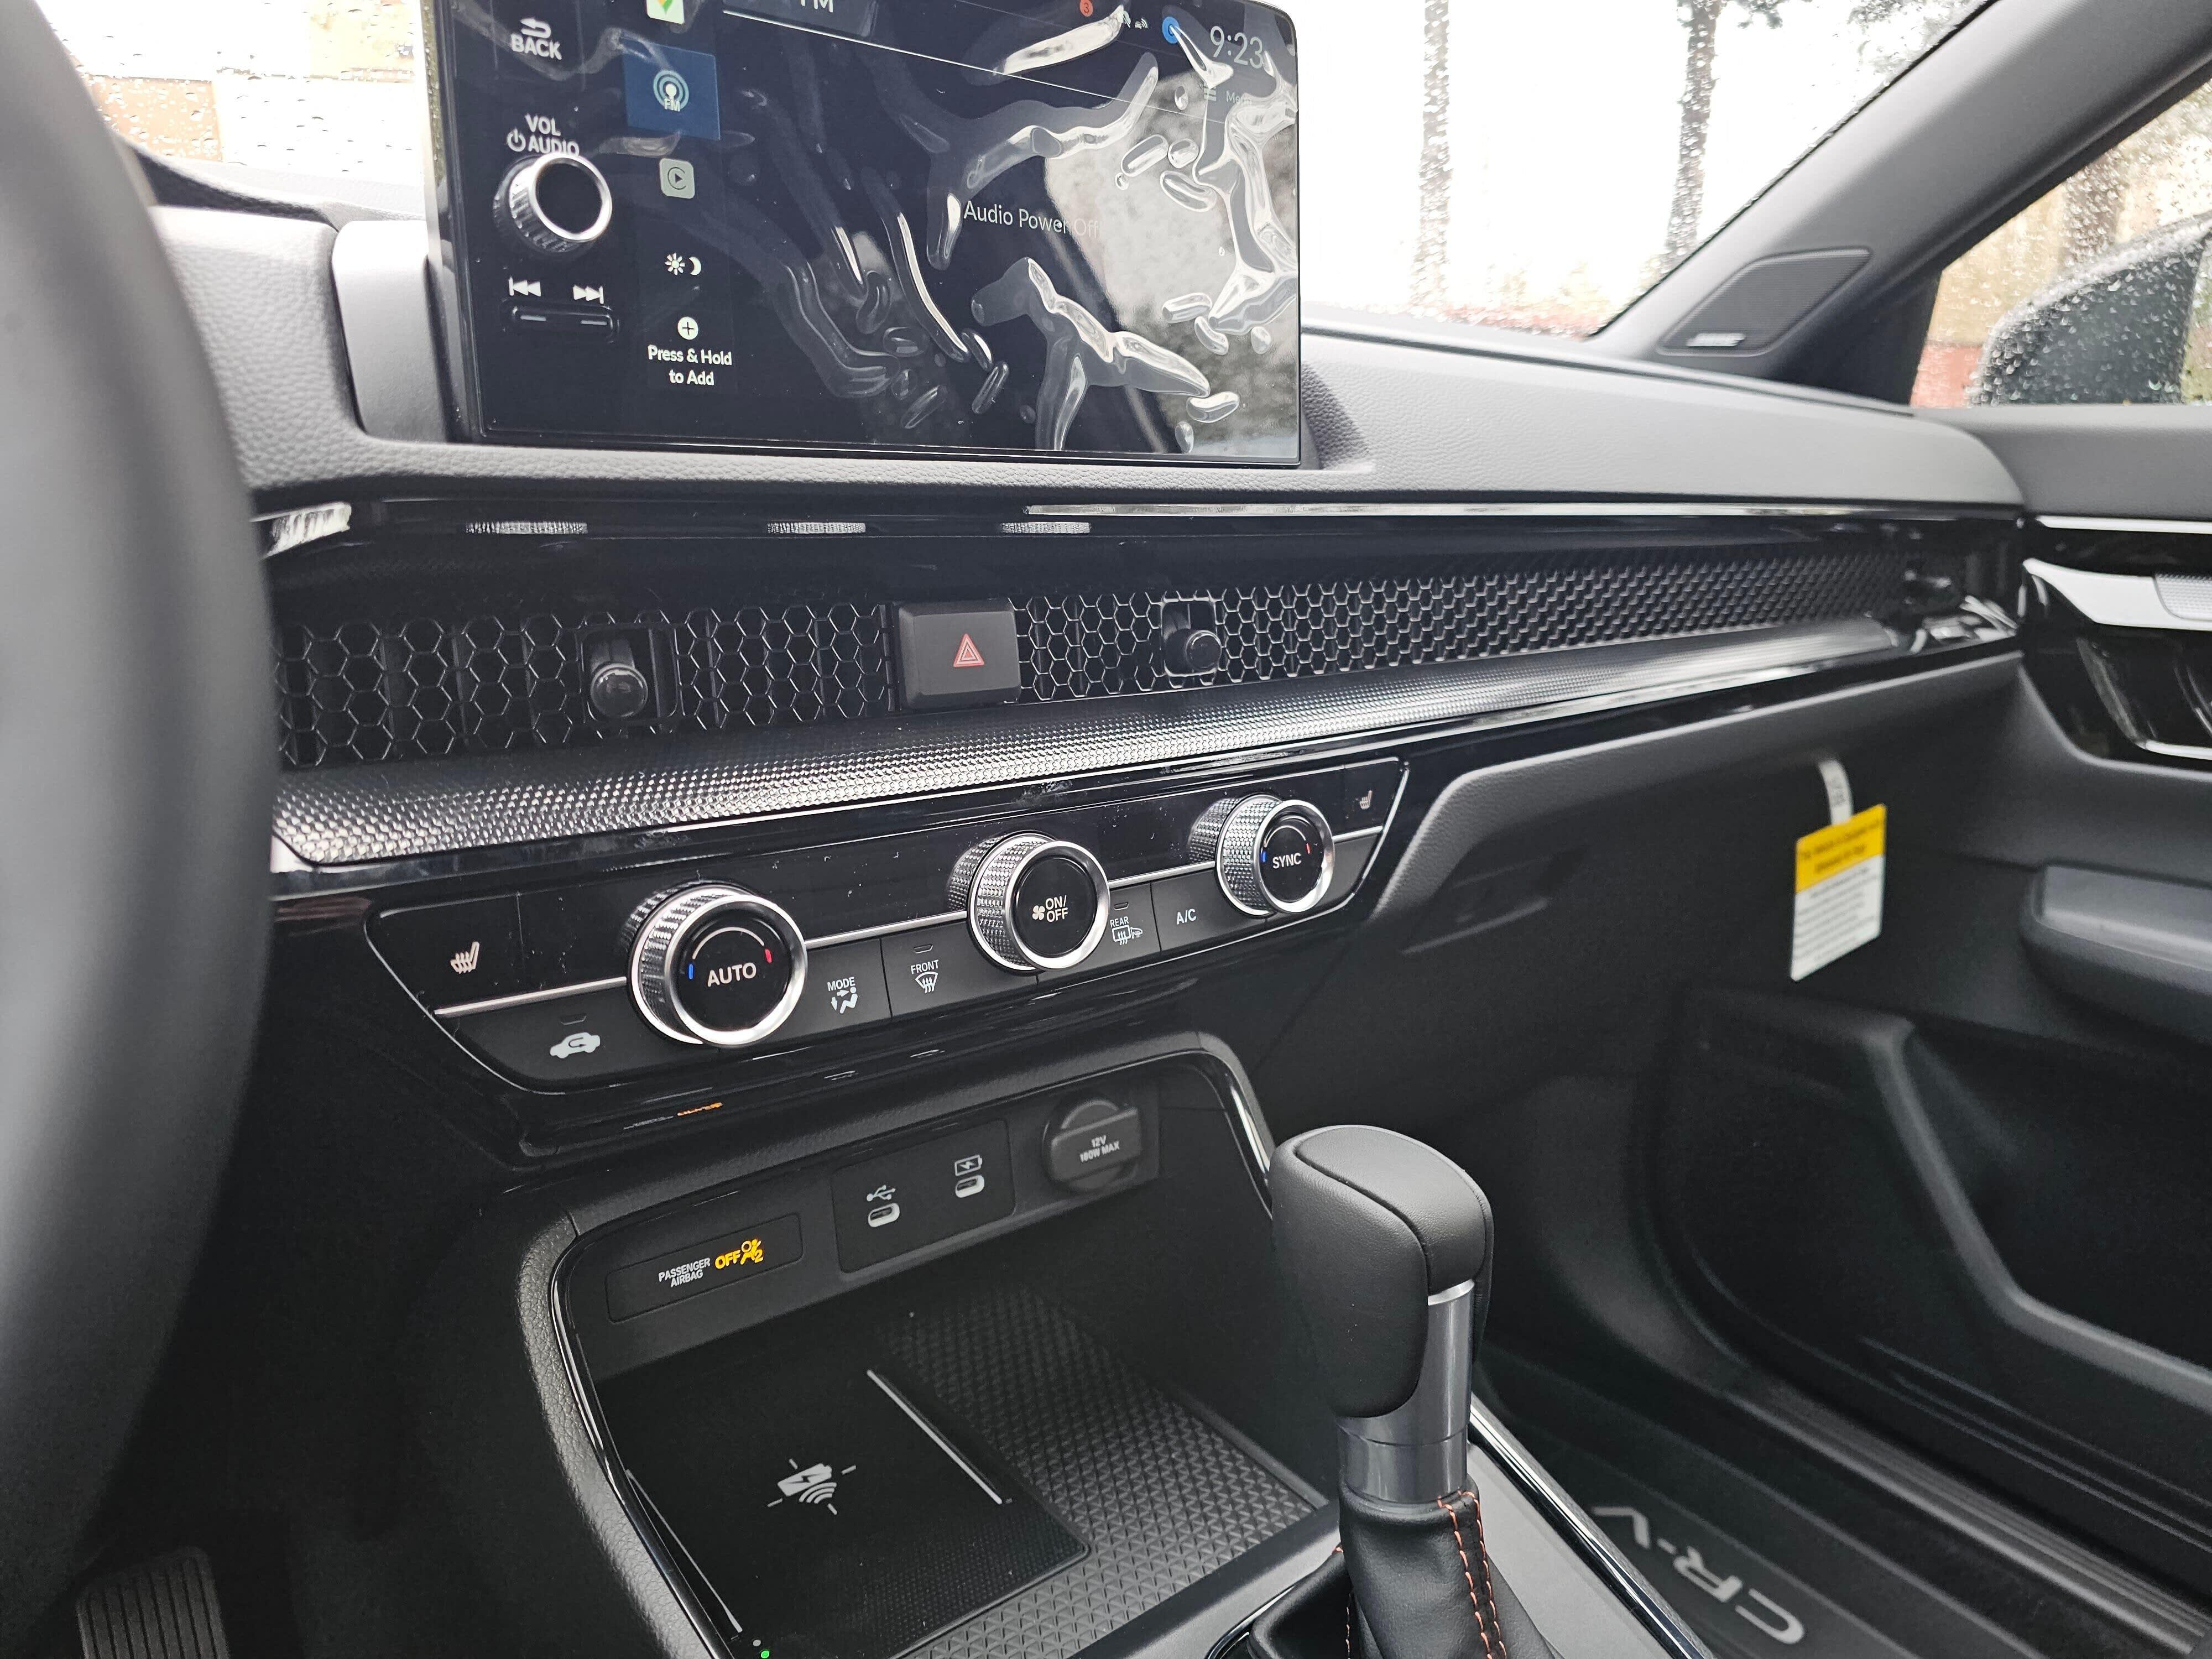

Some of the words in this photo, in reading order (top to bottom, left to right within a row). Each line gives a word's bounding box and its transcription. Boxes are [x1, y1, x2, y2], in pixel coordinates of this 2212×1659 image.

[510, 34, 562, 60] BACK
[1210, 25, 1263, 69] 9:23
[664, 98, 681, 112] FM
[525, 113, 561, 136] VOL
[528, 134, 580, 156] AUDIO
[963, 200, 1013, 226] Audio
[1019, 208, 1068, 234] Power
[648, 345, 684, 362] Press
[686, 348, 698, 363] &
[701, 349, 732, 366] Hold
[669, 369, 684, 384] to
[686, 369, 714, 386] Add
[1272, 852, 1301, 869] SYNC
[1045, 895, 1067, 910] ON/
[1046, 907, 1068, 922] OFF
[1110, 916, 1129, 928] REAR
[1176, 909, 1197, 925] A/C
[707, 962, 757, 987] AUTO
[910, 959, 939, 974] FRONT
[827, 977, 856, 992] MODE
[1091, 1135, 1107, 1147] 12V
[1101, 1141, 1120, 1155] MAX
[714, 1250, 741, 1269] OFF
[658, 1258, 711, 1282] PASSENGER
[670, 1270, 704, 1288] AIRBAG
[1593, 1506, 1805, 1644] CR-V
